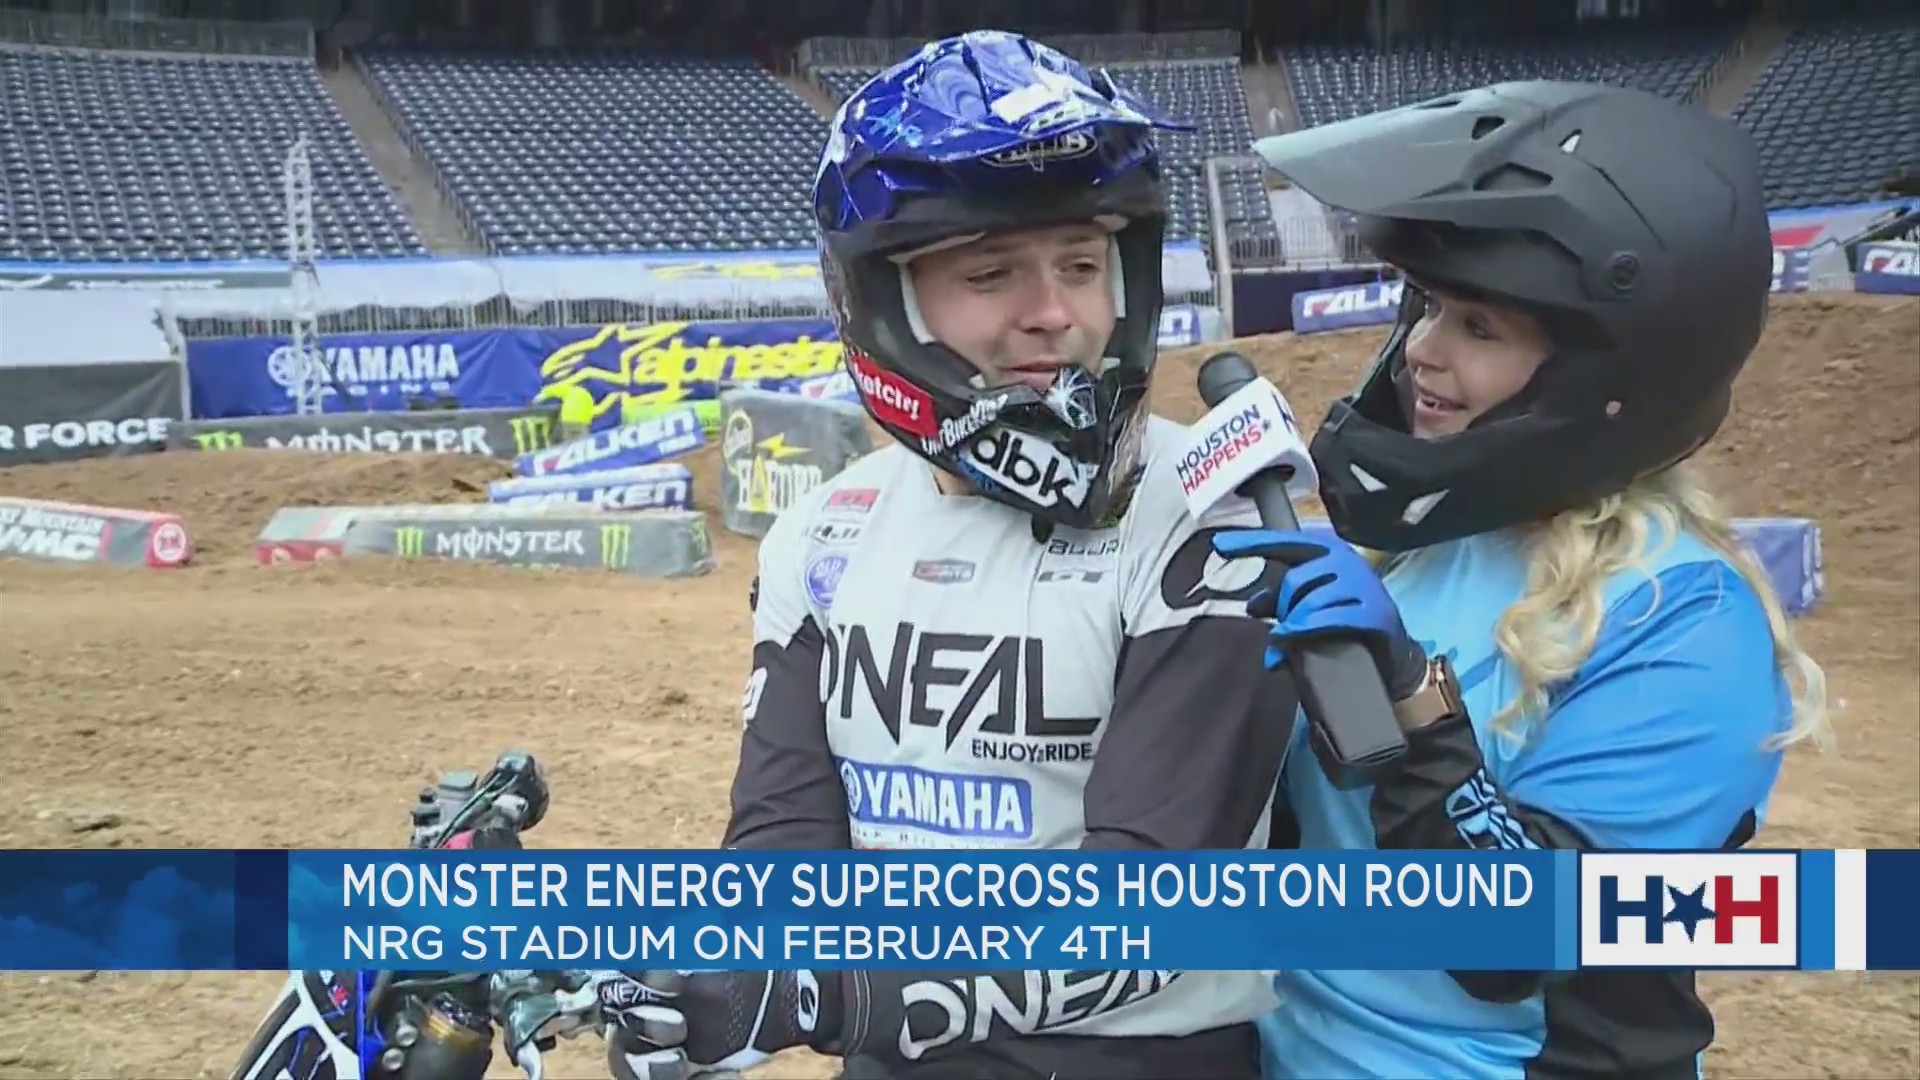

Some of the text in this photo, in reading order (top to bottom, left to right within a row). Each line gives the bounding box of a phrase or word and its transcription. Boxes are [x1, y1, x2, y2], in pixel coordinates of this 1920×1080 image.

[24, 418, 172, 449] FORCE
[533, 411, 694, 476] FALKEN
[972, 431, 1072, 497] dbk
[1176, 404, 1260, 479] HOUSTON
[1183, 424, 1262, 496] HAPPENS
[437, 526, 584, 560] MONSTER
[863, 768, 1025, 832] YAMAHA
